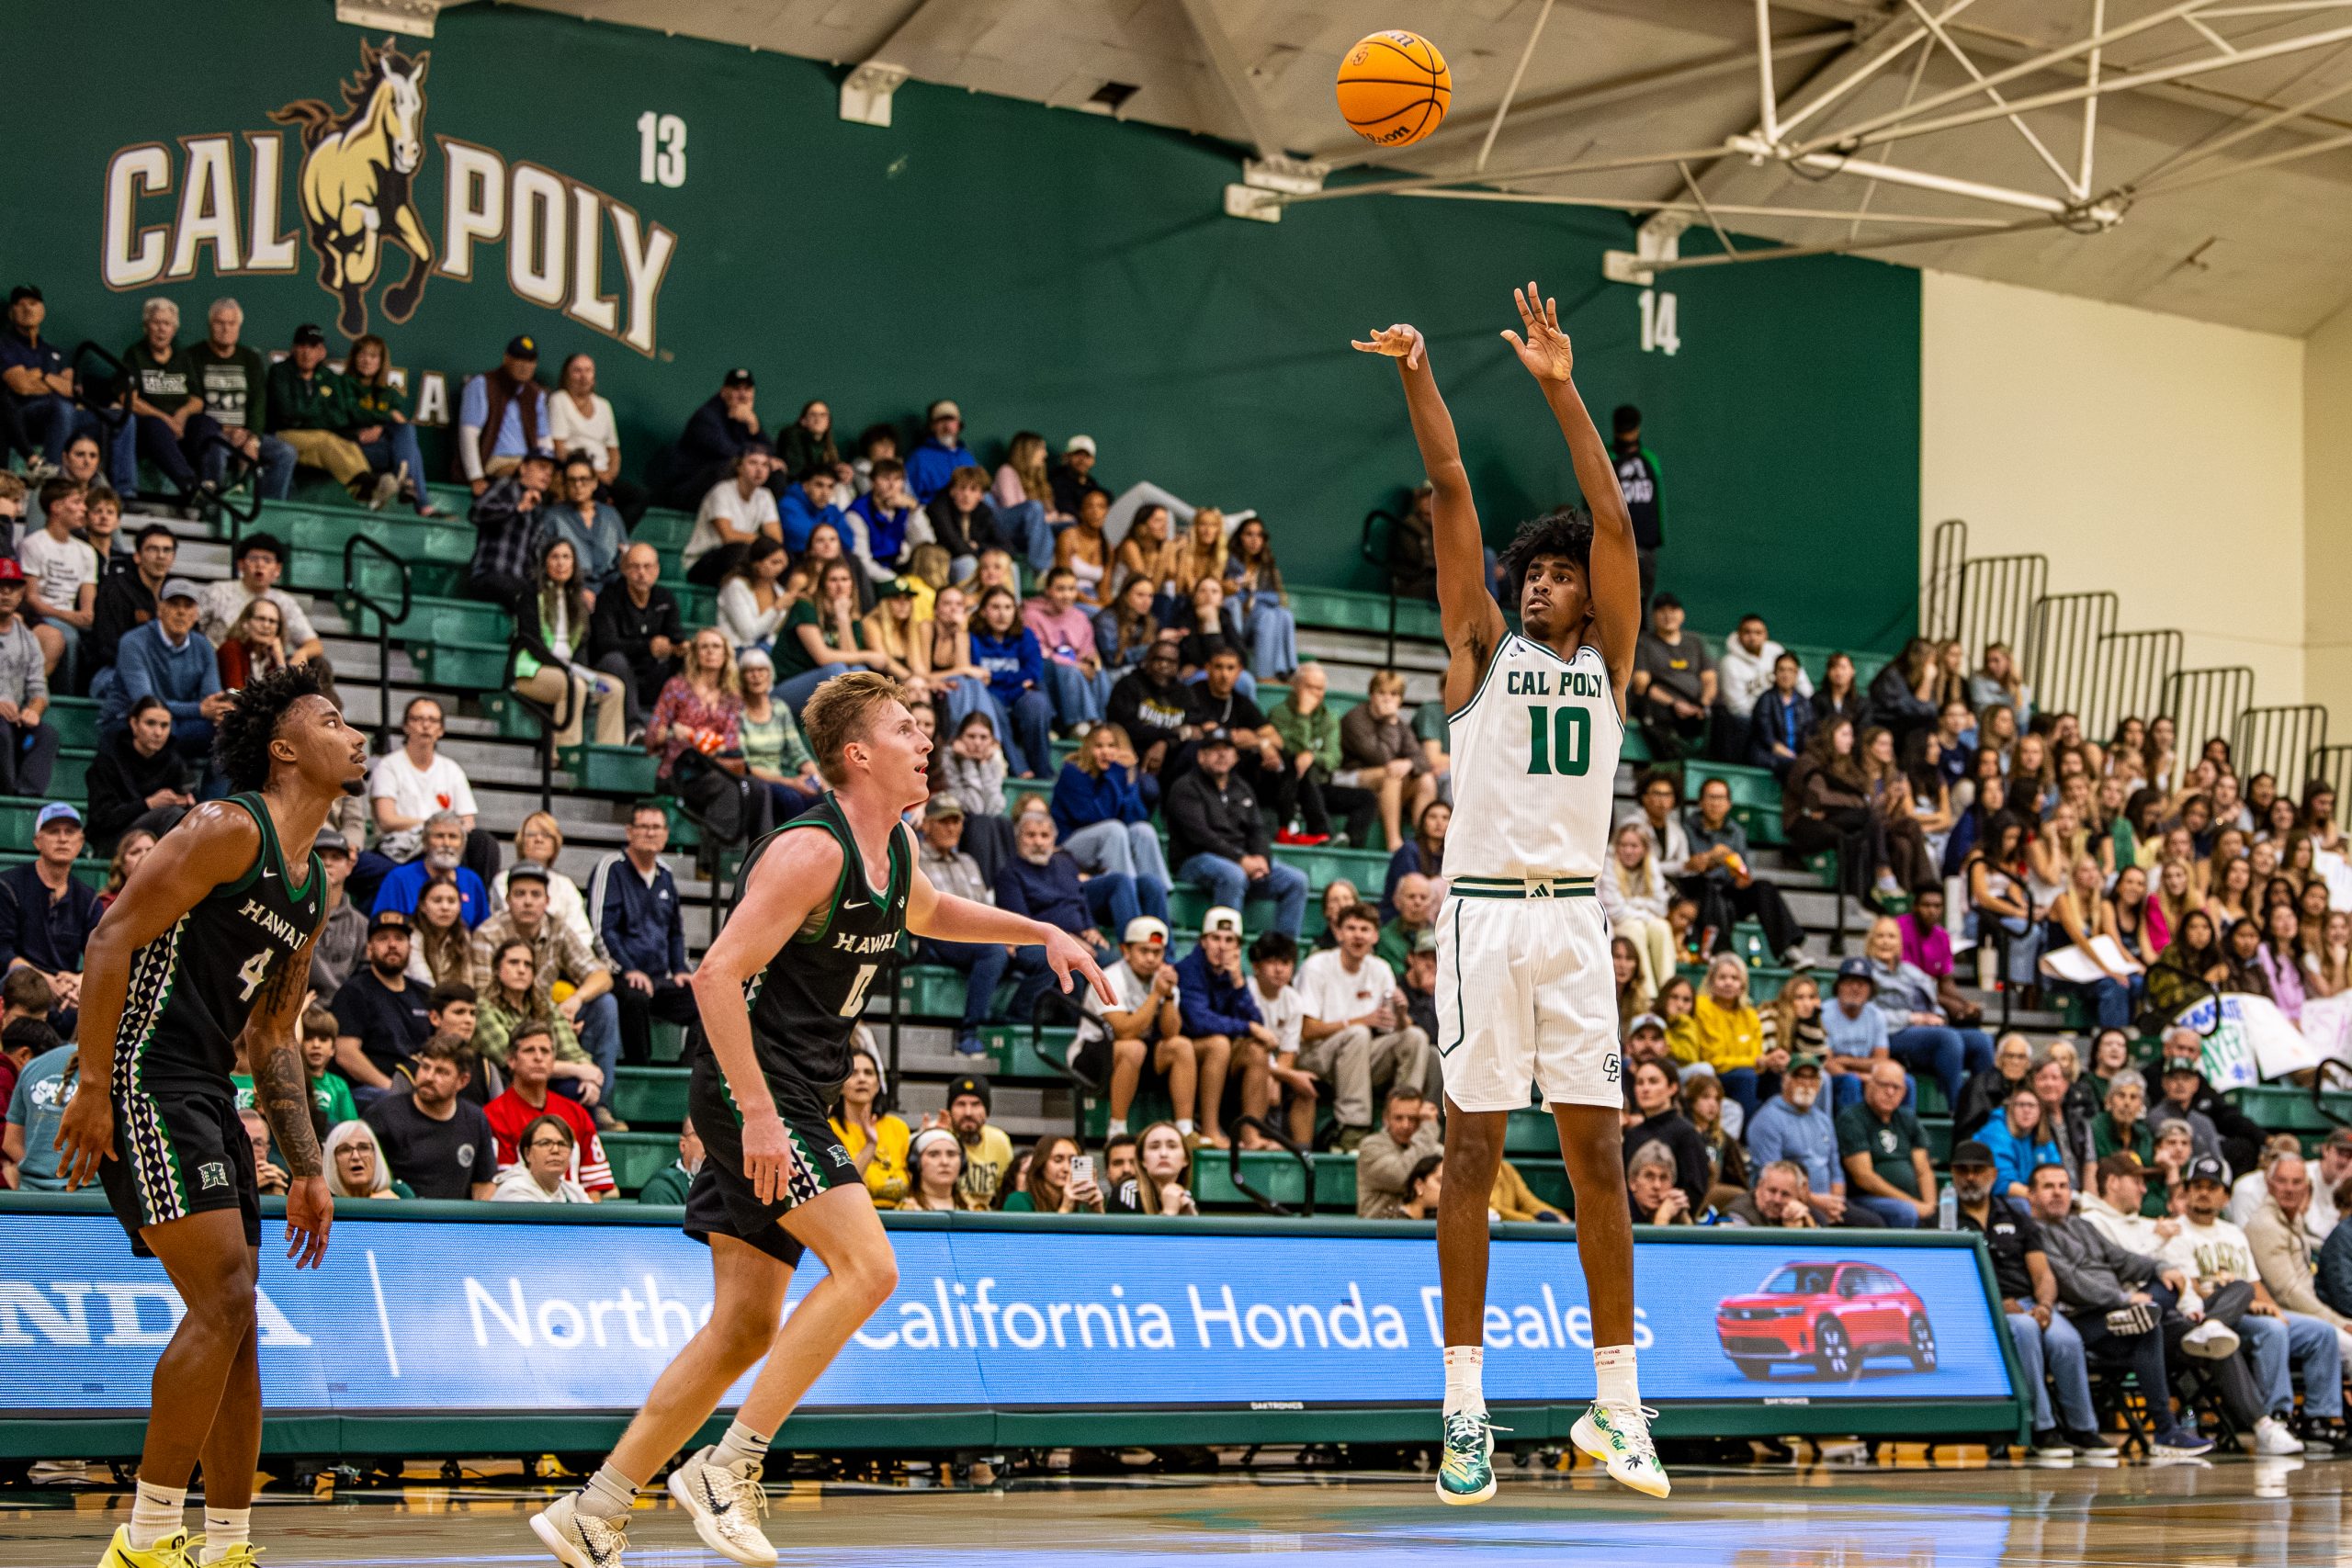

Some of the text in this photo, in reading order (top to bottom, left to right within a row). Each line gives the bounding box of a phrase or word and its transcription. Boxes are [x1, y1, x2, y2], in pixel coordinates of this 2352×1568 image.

[637, 111, 688, 188] 13
[102, 130, 677, 358] CAL POLY
[1637, 288, 1681, 355] 14
[1508, 671, 1602, 698] CAL POLY
[1527, 705, 1591, 776] 10
[238, 948, 274, 1002] 4
[464, 1275, 799, 1348] North
[1187, 1280, 1409, 1349] Honda
[1419, 1282, 1654, 1348] eales
